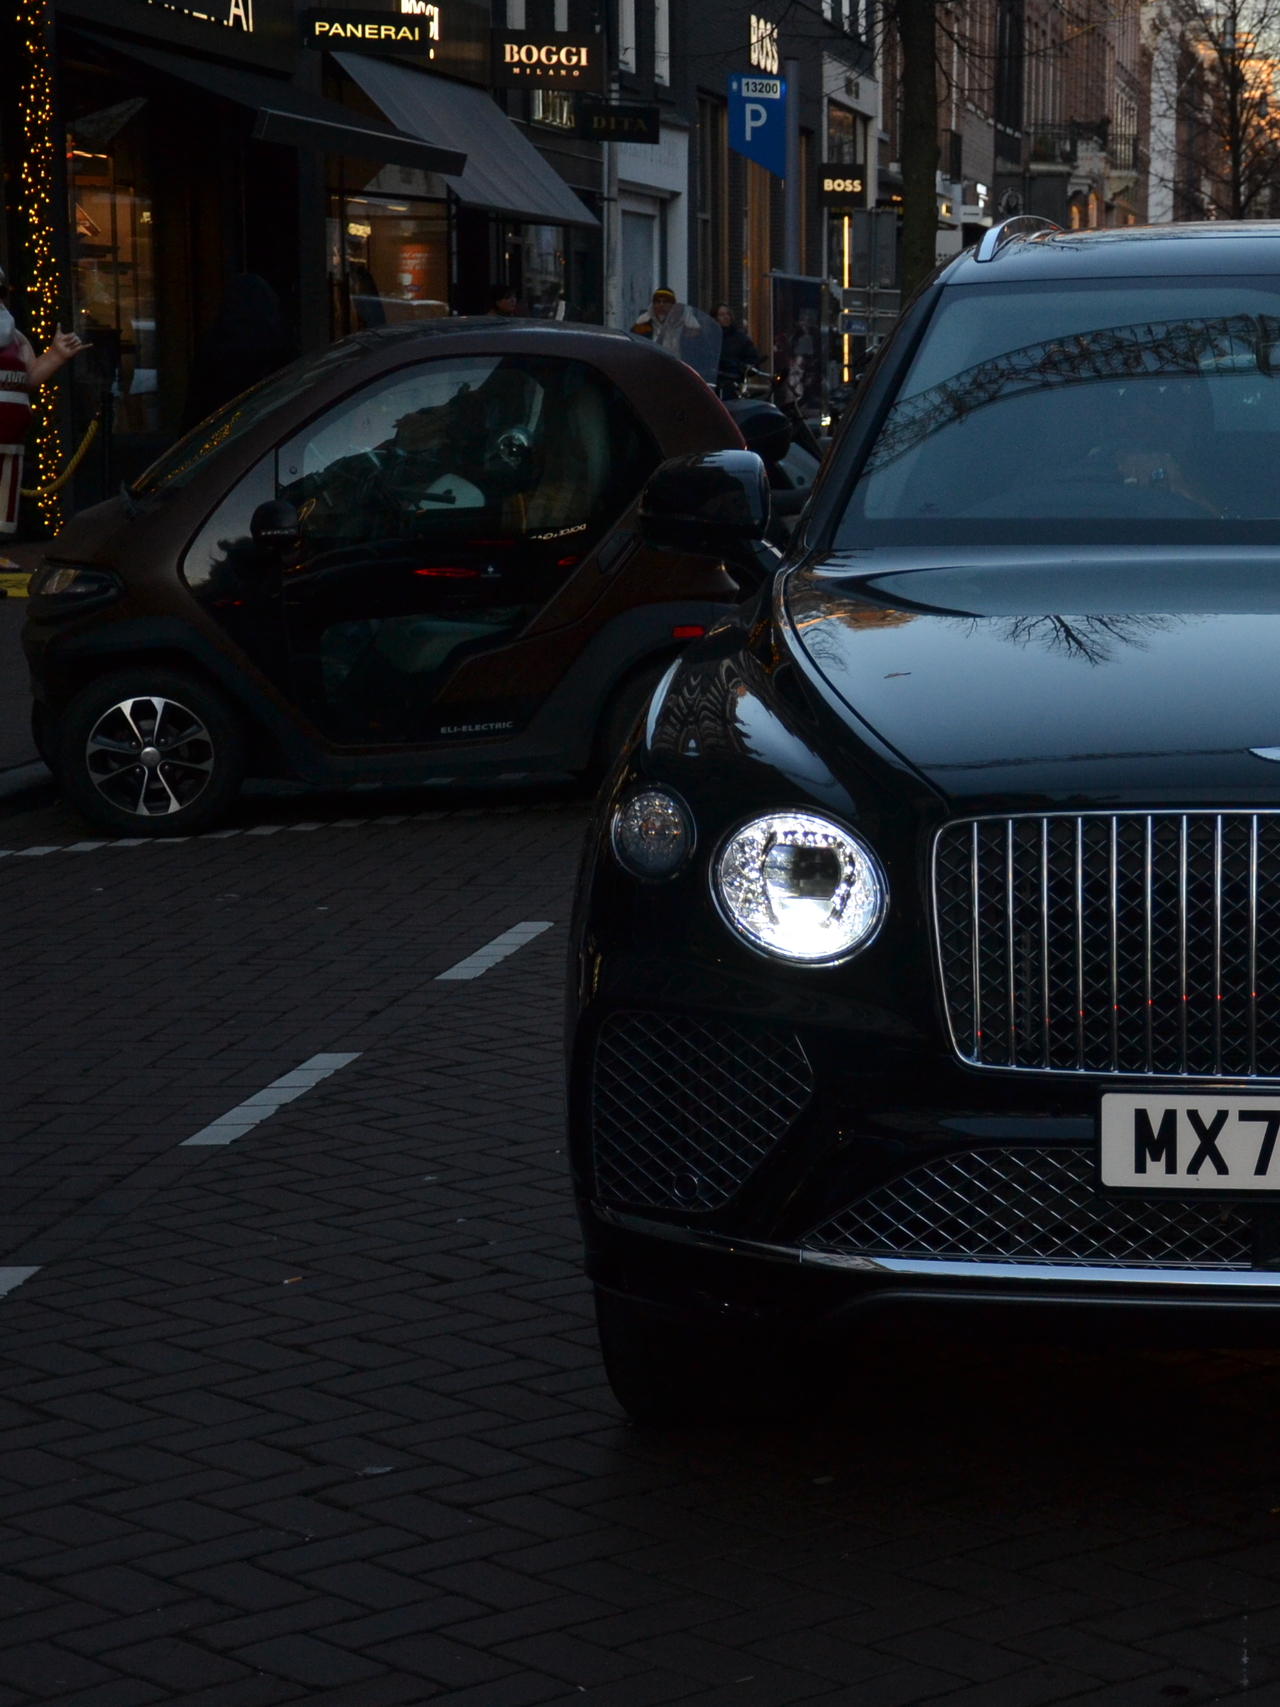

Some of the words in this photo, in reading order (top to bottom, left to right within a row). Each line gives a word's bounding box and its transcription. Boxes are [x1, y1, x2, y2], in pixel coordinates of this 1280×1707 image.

[314, 21, 420, 41] PANERAI
[503, 43, 589, 67] BOGGI
[512, 67, 580, 77] MILANO
[744, 81, 778, 95] 13200
[592, 114, 648, 132] DITA
[744, 103, 768, 142] P
[823, 178, 862, 192] BOSS
[440, 721, 514, 734] ELI-ELECTRIC
